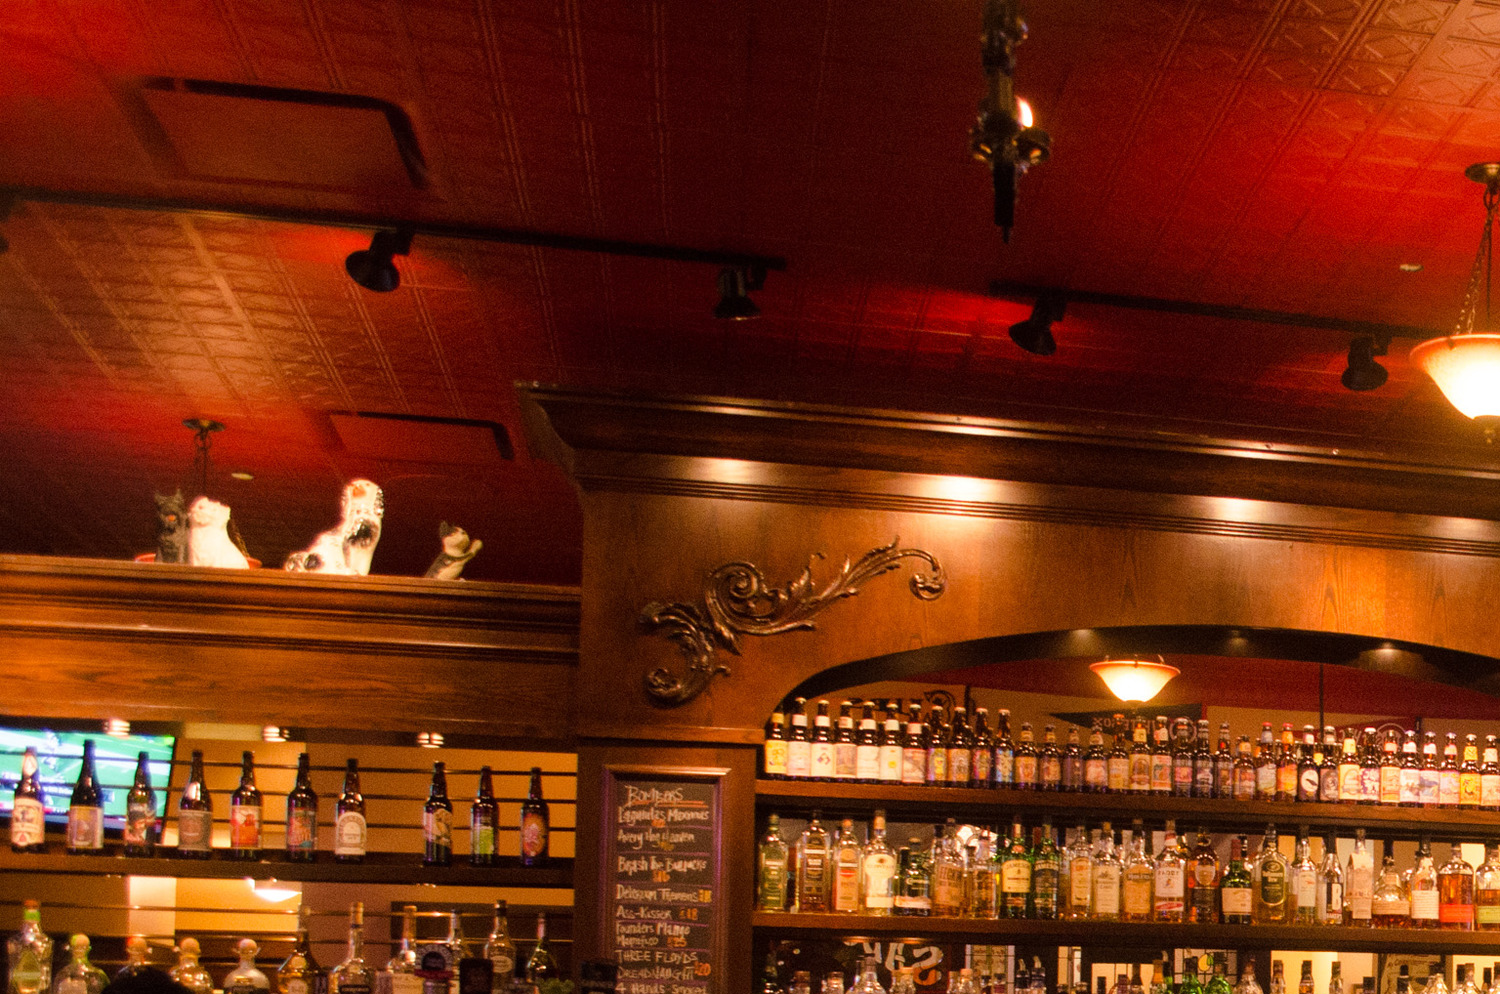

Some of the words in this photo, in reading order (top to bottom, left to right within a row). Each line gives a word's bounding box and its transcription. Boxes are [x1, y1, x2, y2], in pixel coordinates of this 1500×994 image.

[614, 949, 650, 963] THREE
[654, 951, 698, 965] FLOYDS
[615, 982, 627, 994] 4
